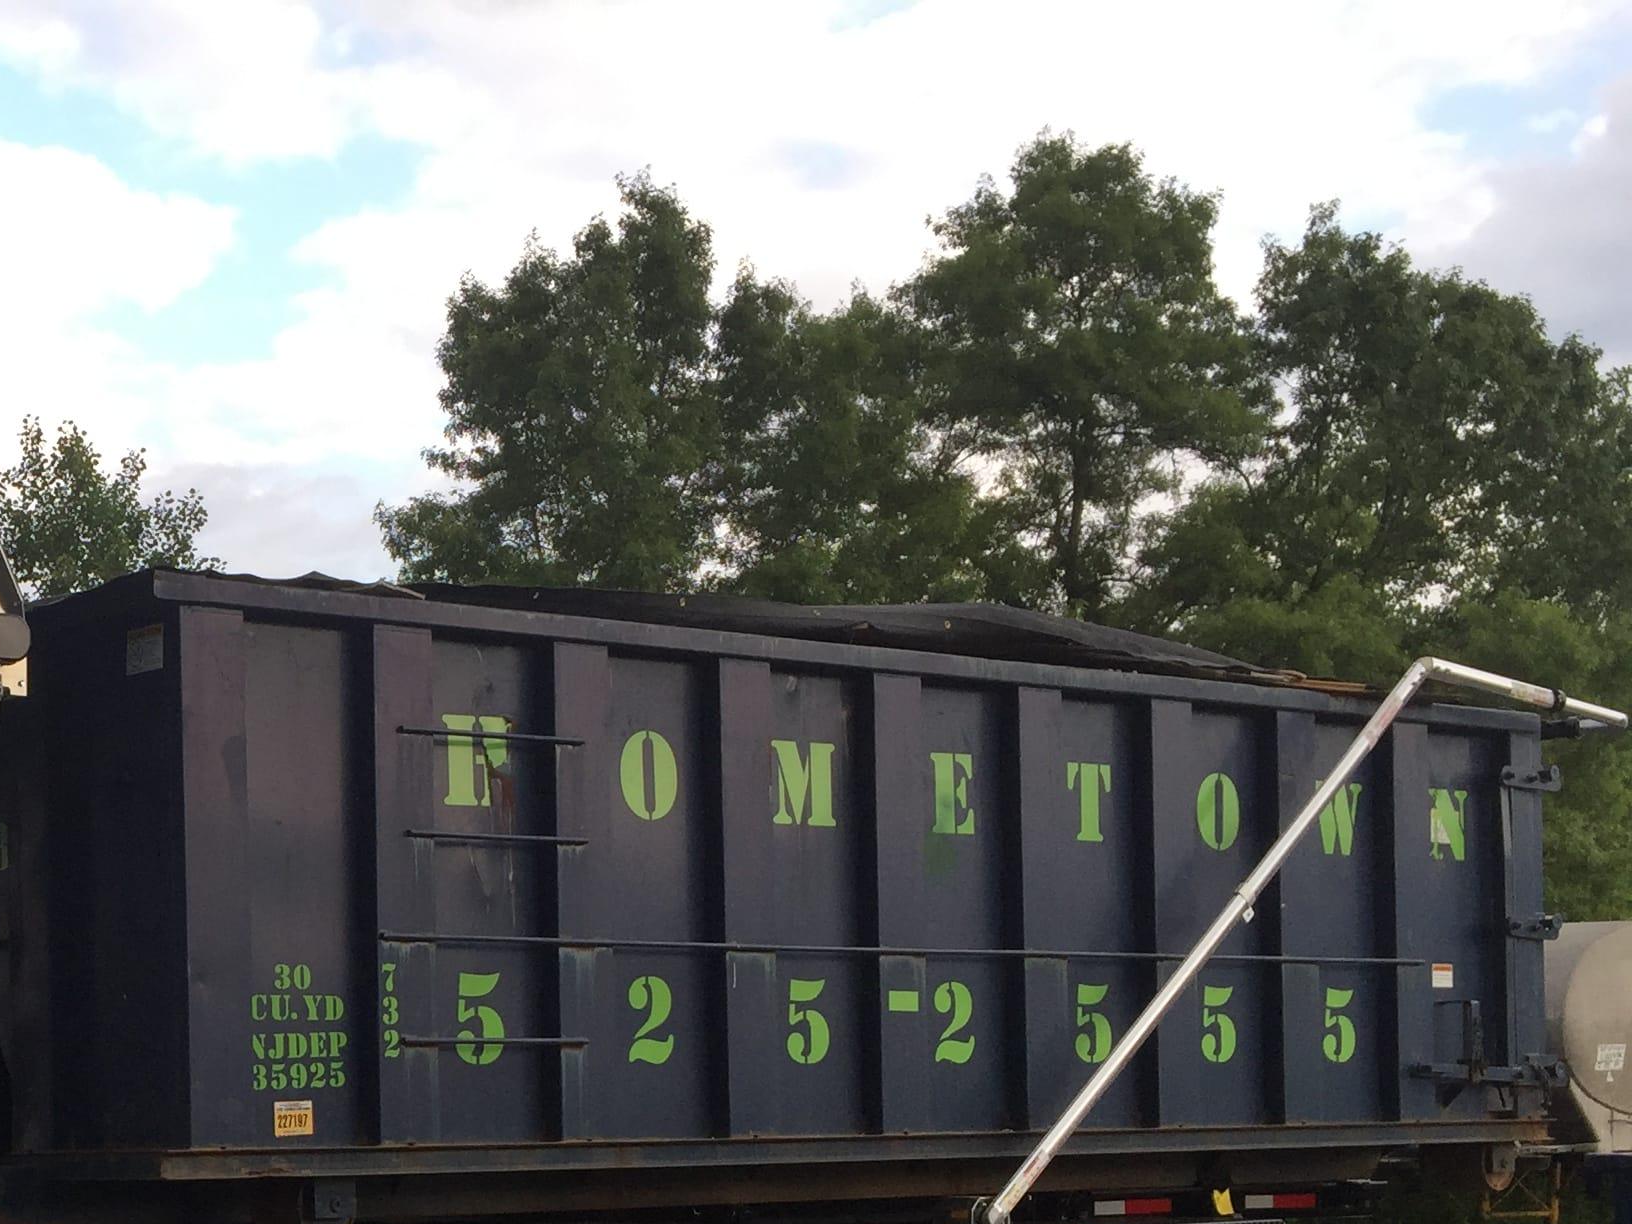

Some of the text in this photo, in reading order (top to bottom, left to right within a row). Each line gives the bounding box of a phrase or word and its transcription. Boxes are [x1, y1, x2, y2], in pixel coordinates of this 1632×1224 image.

[274, 964, 312, 990] 30
[252, 1032, 348, 1060] NJDEP
[253, 1062, 347, 1091] 35925
[277, 1113, 309, 1129] 227197
